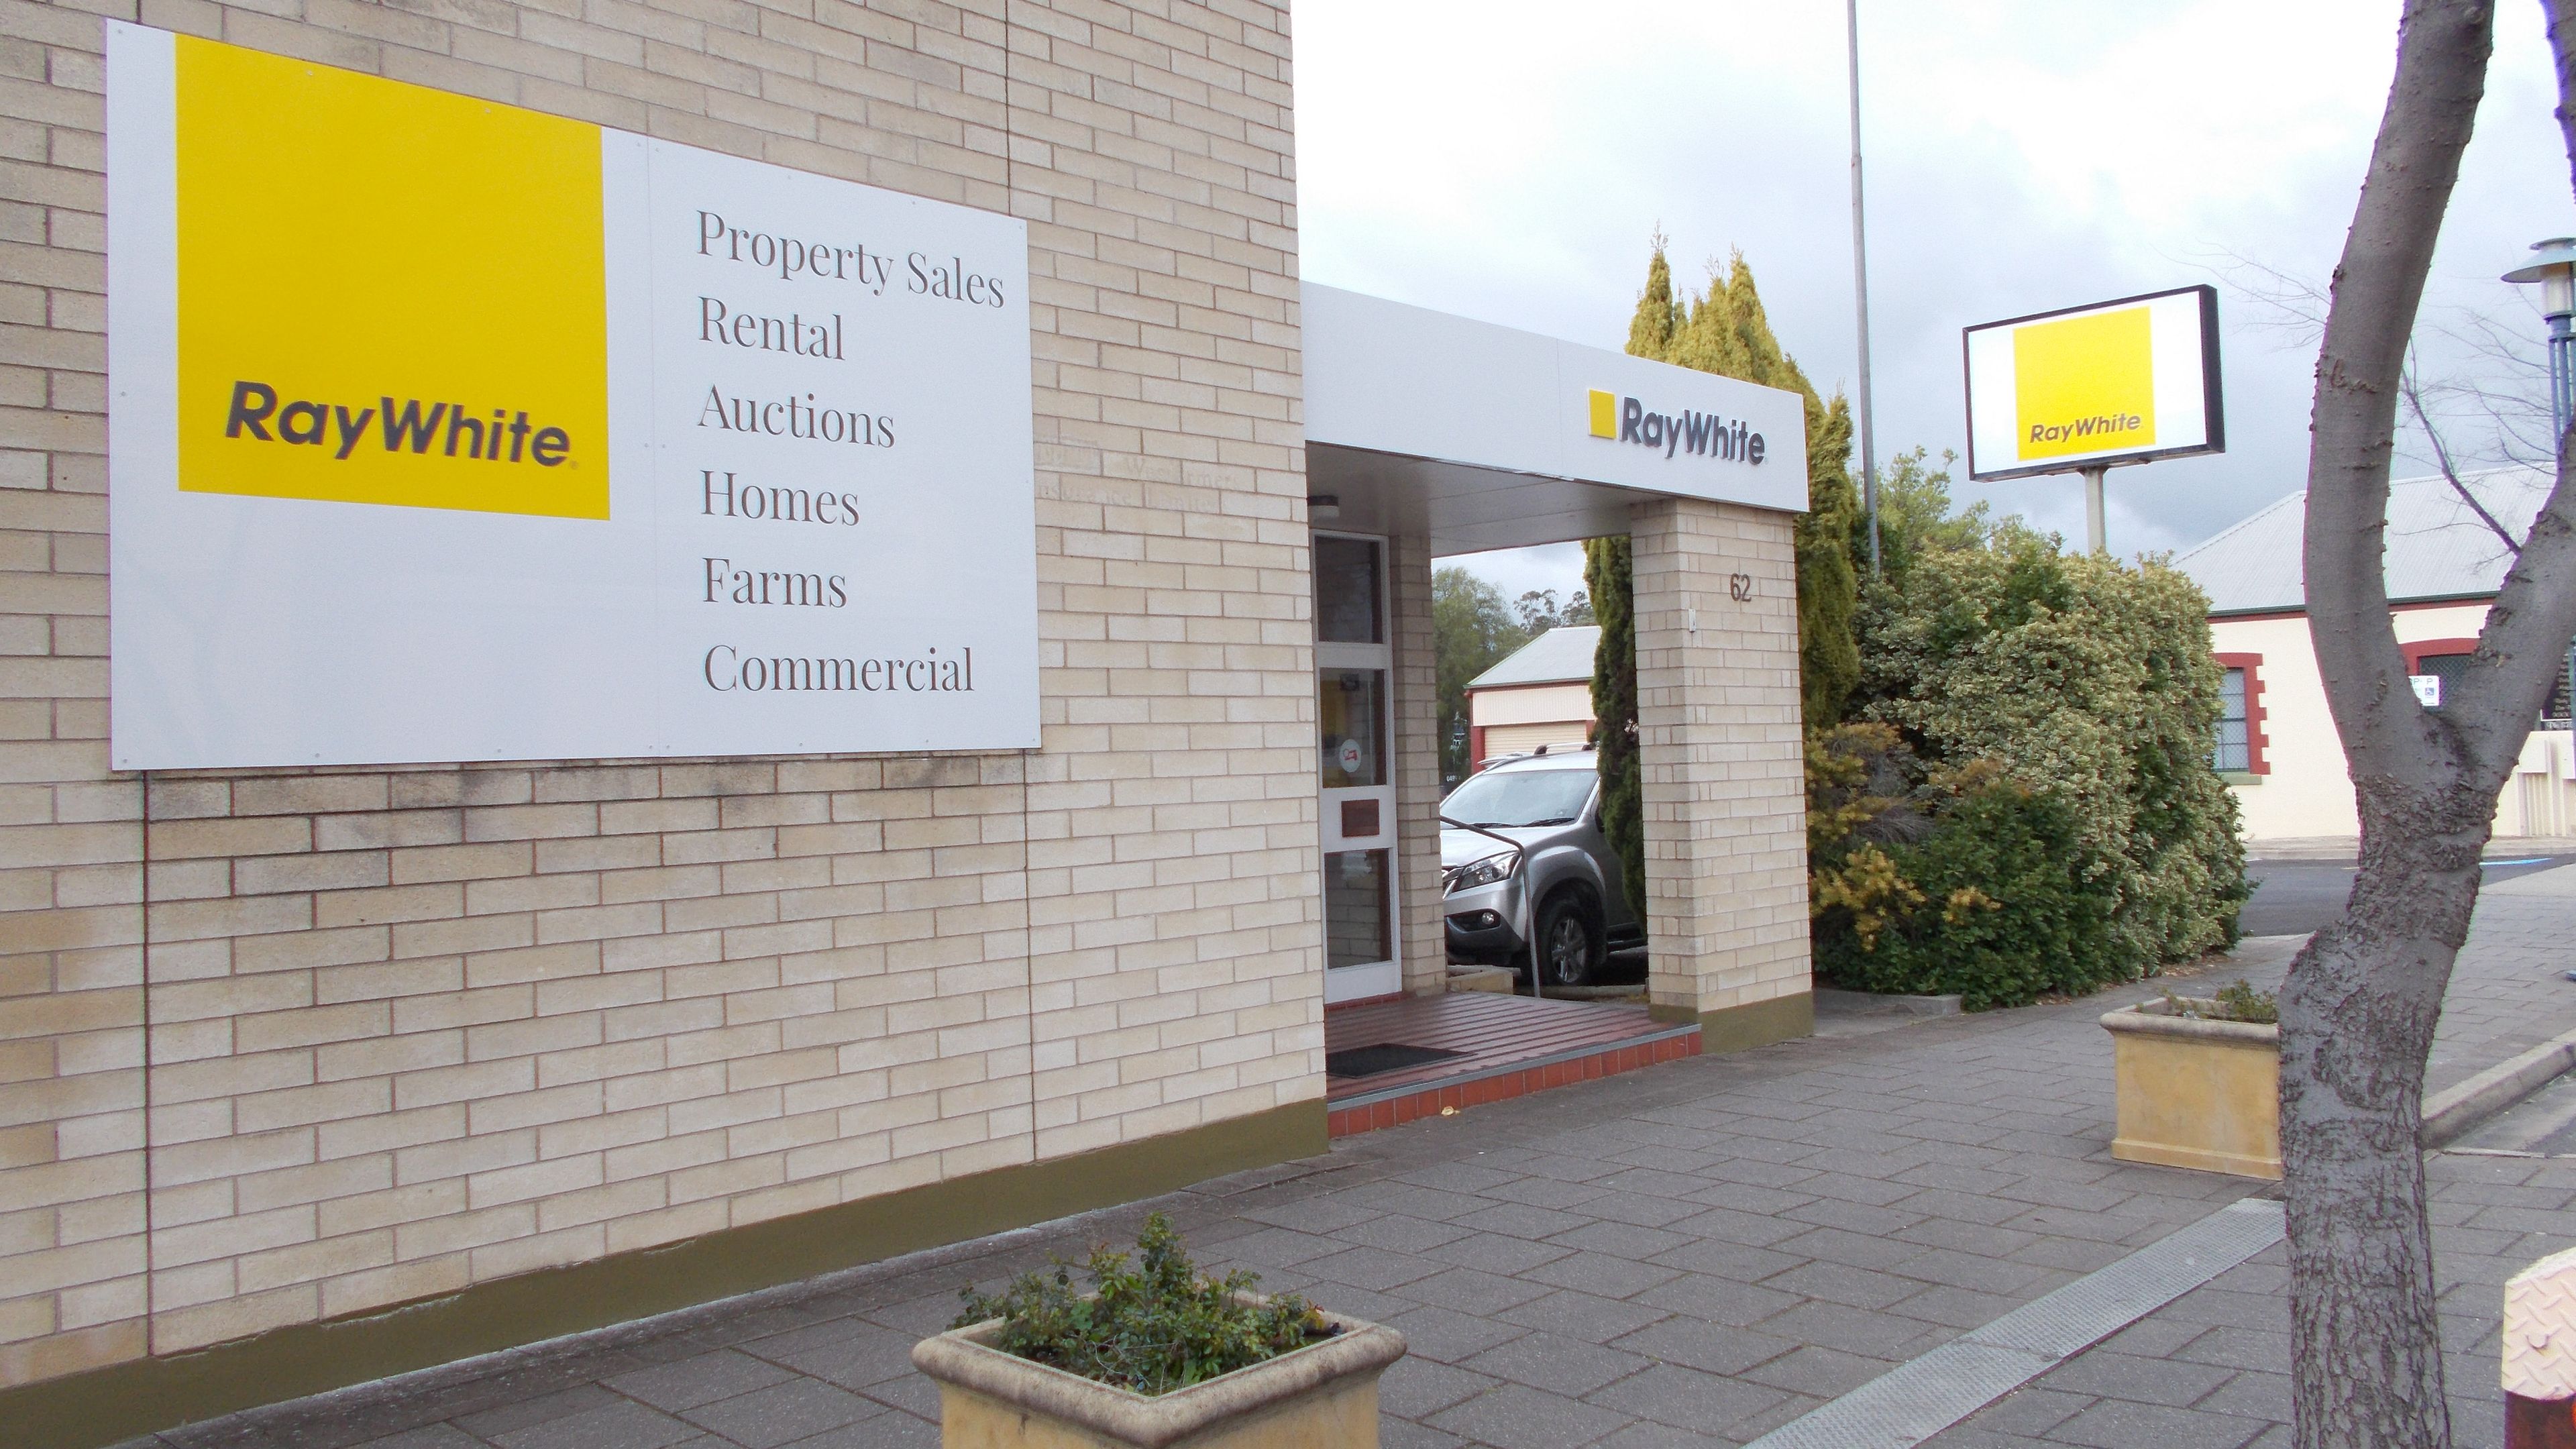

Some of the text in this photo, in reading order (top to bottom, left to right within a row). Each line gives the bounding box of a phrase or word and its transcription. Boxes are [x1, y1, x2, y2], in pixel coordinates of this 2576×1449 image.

[696, 210, 1004, 308] Property Sales
[698, 296, 845, 361] Rental
[225, 380, 571, 468] RayWhite
[697, 384, 895, 448] Auctions
[1620, 396, 1766, 465] RayWhite
[2029, 413, 2141, 443] RayWhite
[700, 470, 859, 527] Homes
[702, 557, 847, 608] Farms
[1729, 573, 1752, 603] 62
[704, 645, 975, 692] Commercial
